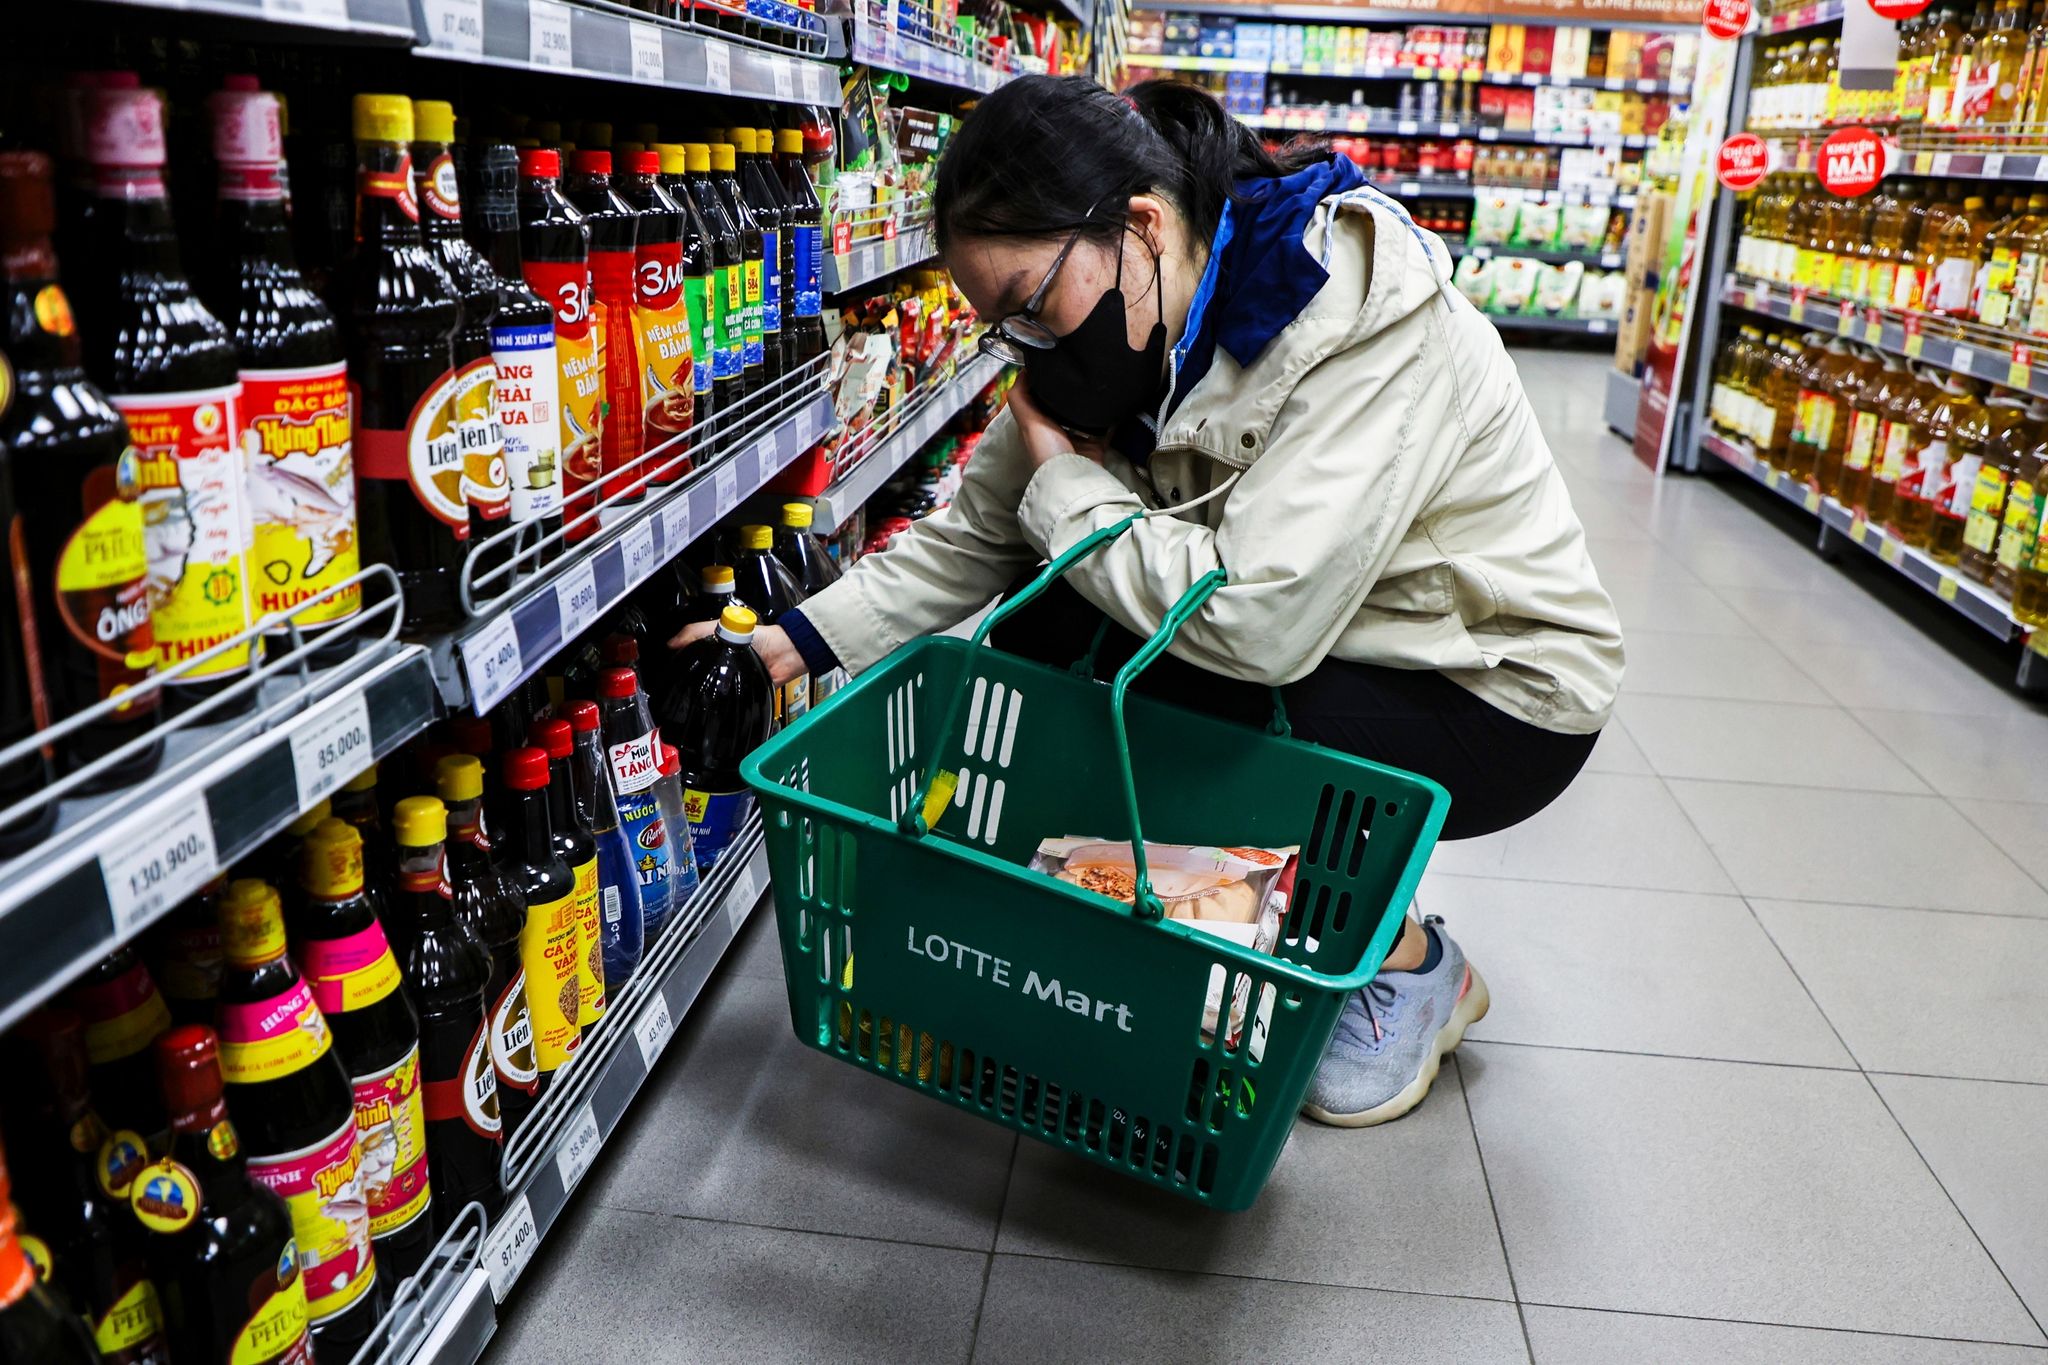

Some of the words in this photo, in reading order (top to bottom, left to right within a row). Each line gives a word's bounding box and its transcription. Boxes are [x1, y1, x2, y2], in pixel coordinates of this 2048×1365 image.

[684, 802, 702, 815] 584
[543, 942, 564, 960] CÁ
[907, 925, 1012, 988] LOTTE
[1021, 970, 1135, 1033] Mart
[502, 1022, 529, 1052] Liên
